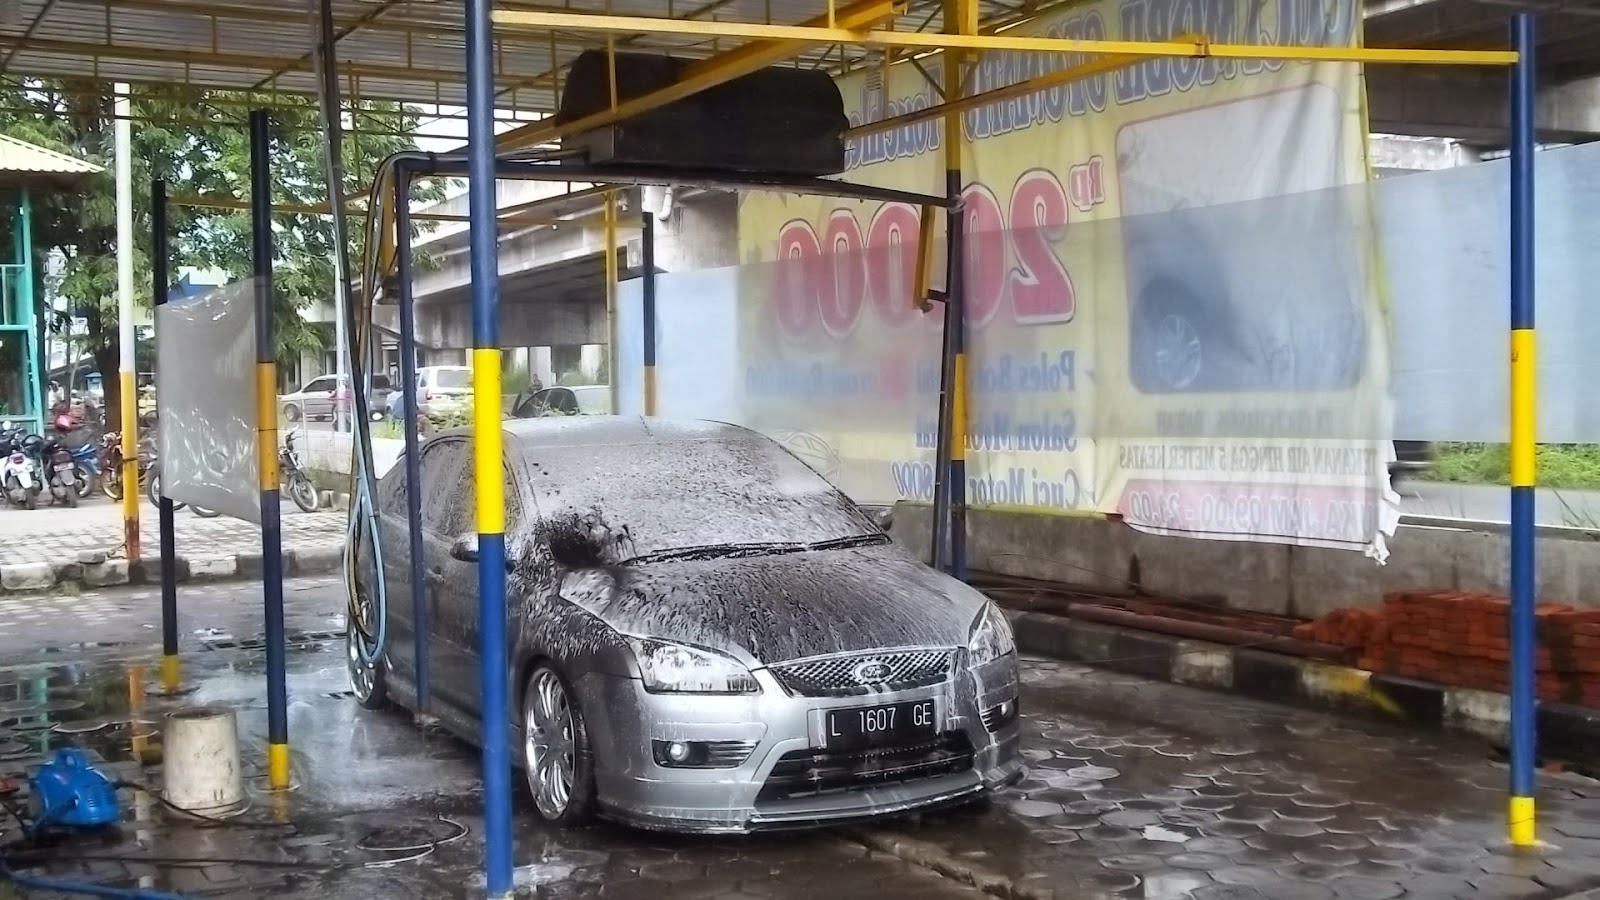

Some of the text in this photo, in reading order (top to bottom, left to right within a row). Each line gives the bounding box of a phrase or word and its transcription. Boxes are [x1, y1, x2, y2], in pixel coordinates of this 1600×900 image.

[831, 702, 932, 737] L 1607 GE
